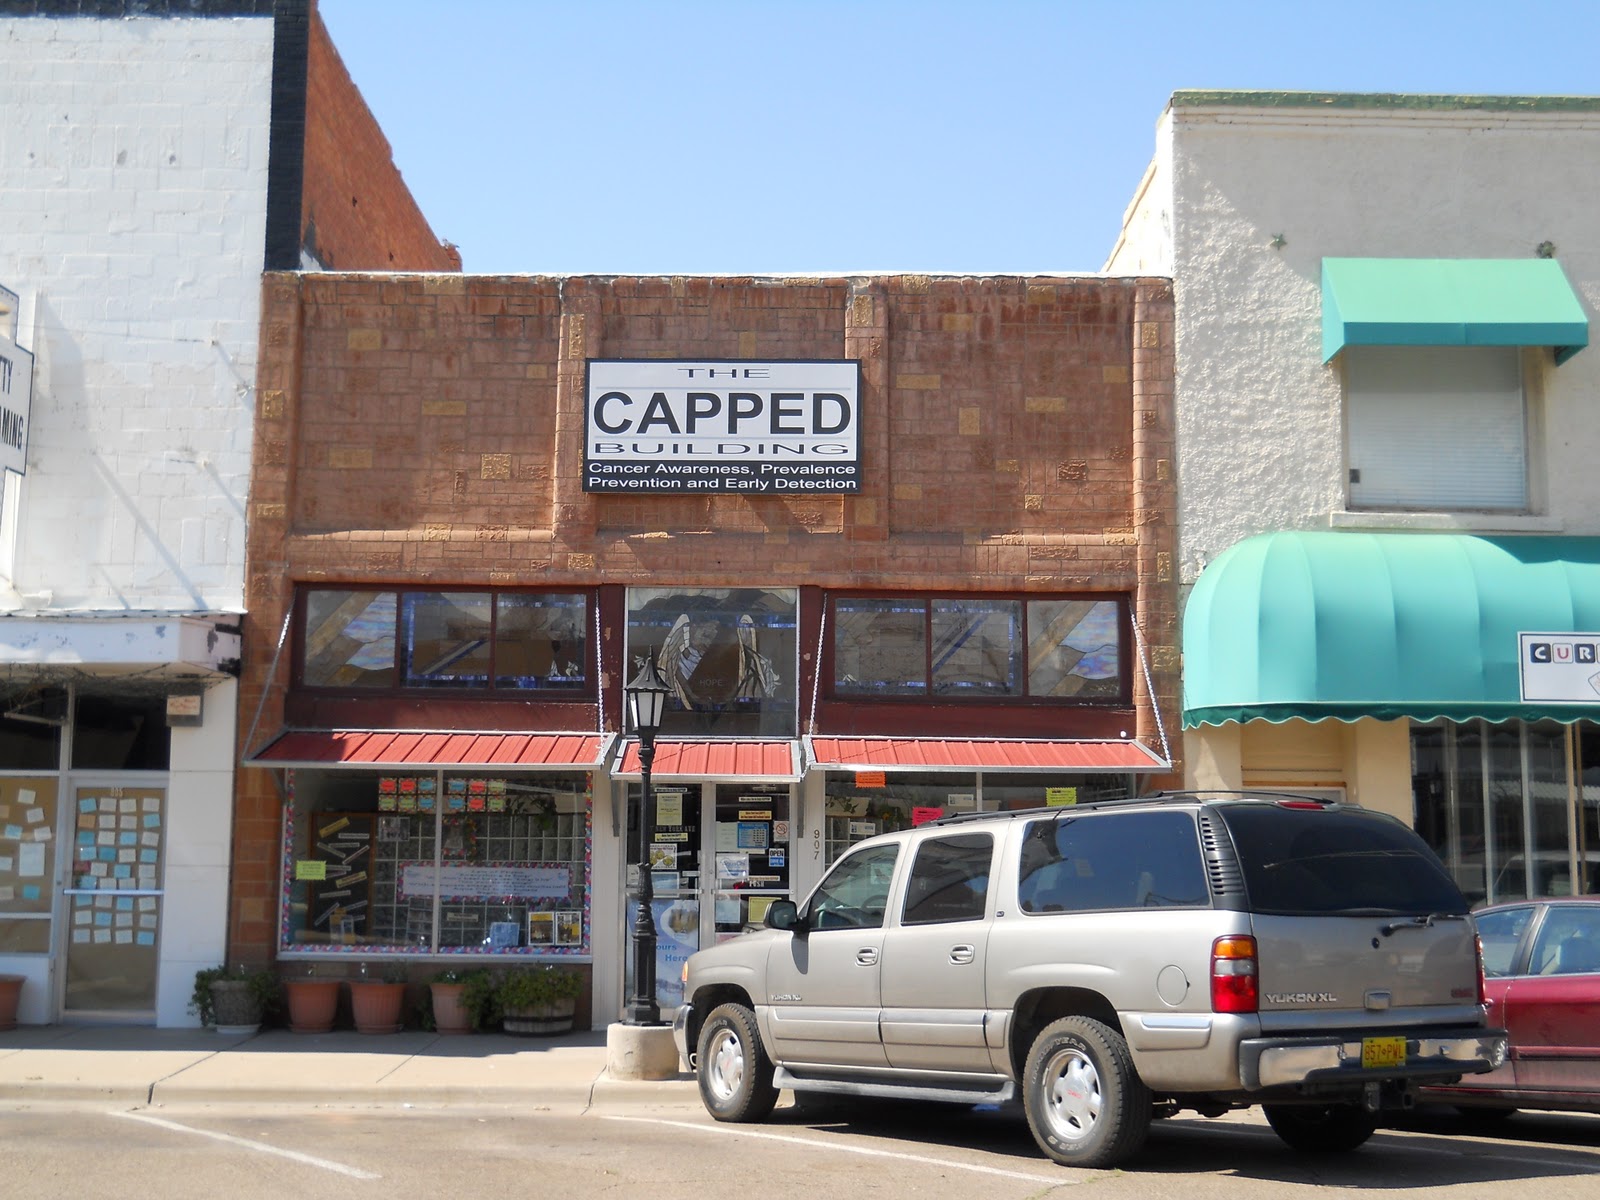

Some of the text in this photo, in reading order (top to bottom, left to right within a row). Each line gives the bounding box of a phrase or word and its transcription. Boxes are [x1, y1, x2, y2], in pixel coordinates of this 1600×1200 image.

[677, 368, 770, 379] THE
[593, 391, 852, 435] CAPPED
[0, 405, 24, 450] MING
[594, 443, 849, 455] BUILDING
[589, 463, 856, 476] Cancer Awareness, Prevalence
[589, 477, 857, 491] Prevention and Early Detection
[1533, 645, 1593, 660] CUR
[699, 678, 723, 687] HOPE
[665, 954, 689, 962] Here
[1265, 992, 1337, 1003] YUKON XL
